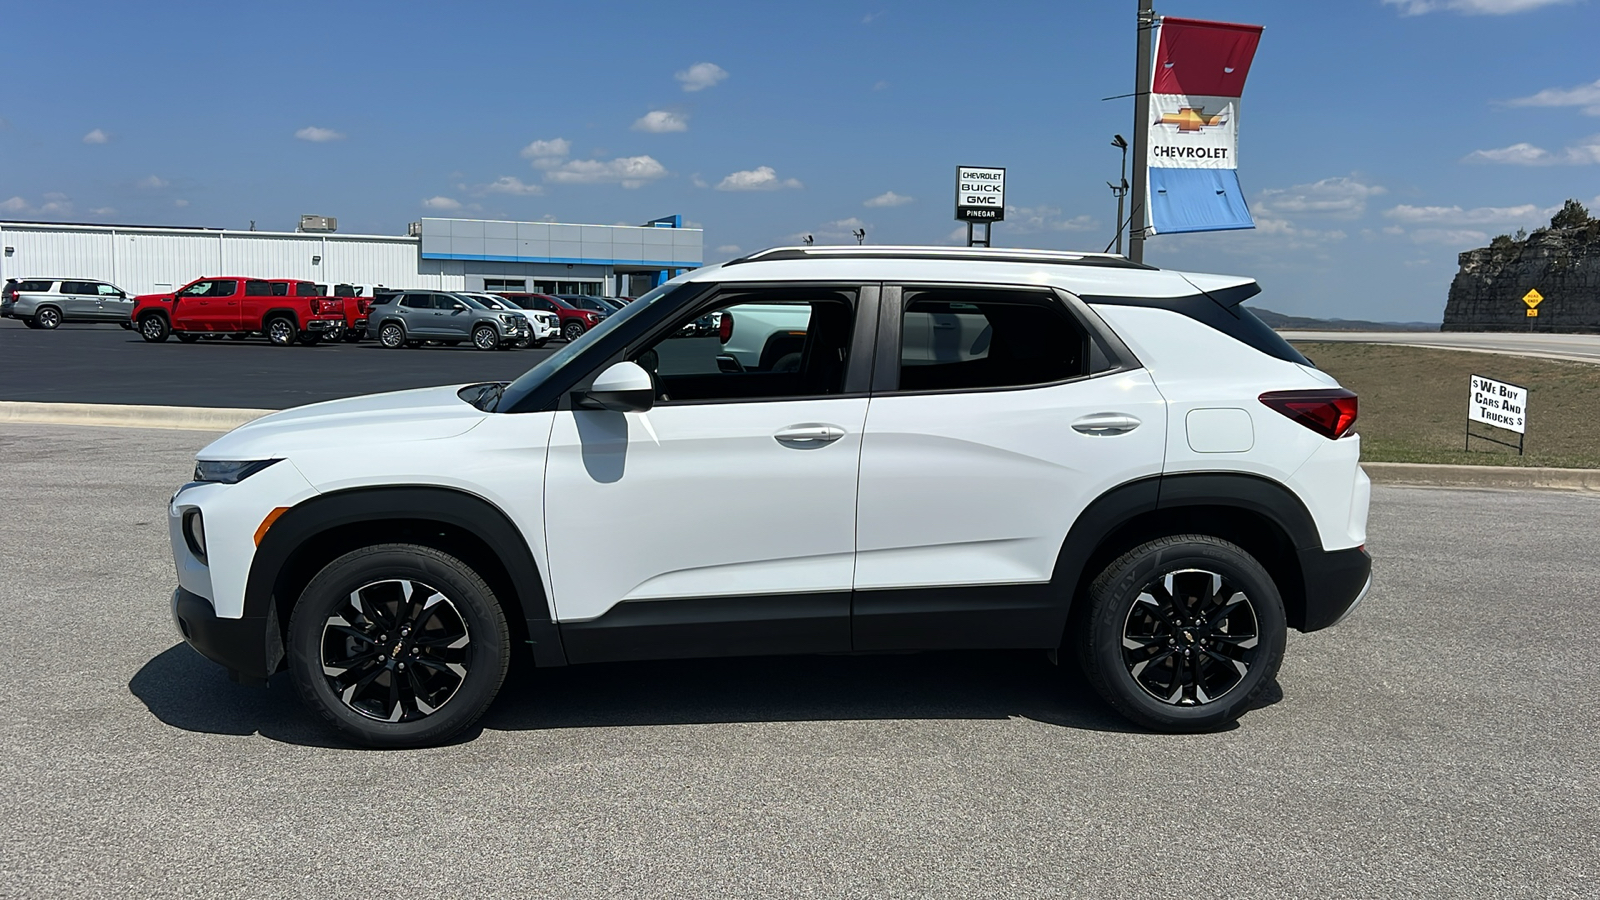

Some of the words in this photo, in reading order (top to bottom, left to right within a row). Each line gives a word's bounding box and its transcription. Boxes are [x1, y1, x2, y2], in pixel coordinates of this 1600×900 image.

[1153, 145, 1228, 159] CHEVROLET
[962, 172, 1002, 180] CHEVROLET
[962, 184, 1002, 192] BUICK
[966, 196, 996, 204] GMC
[1500, 386, 1518, 400] BUY
[1475, 392, 1500, 409] CARS
[1502, 400, 1520, 414] AND
[1480, 406, 1514, 426] TRUCKS
[1104, 570, 1138, 627] KELLY
